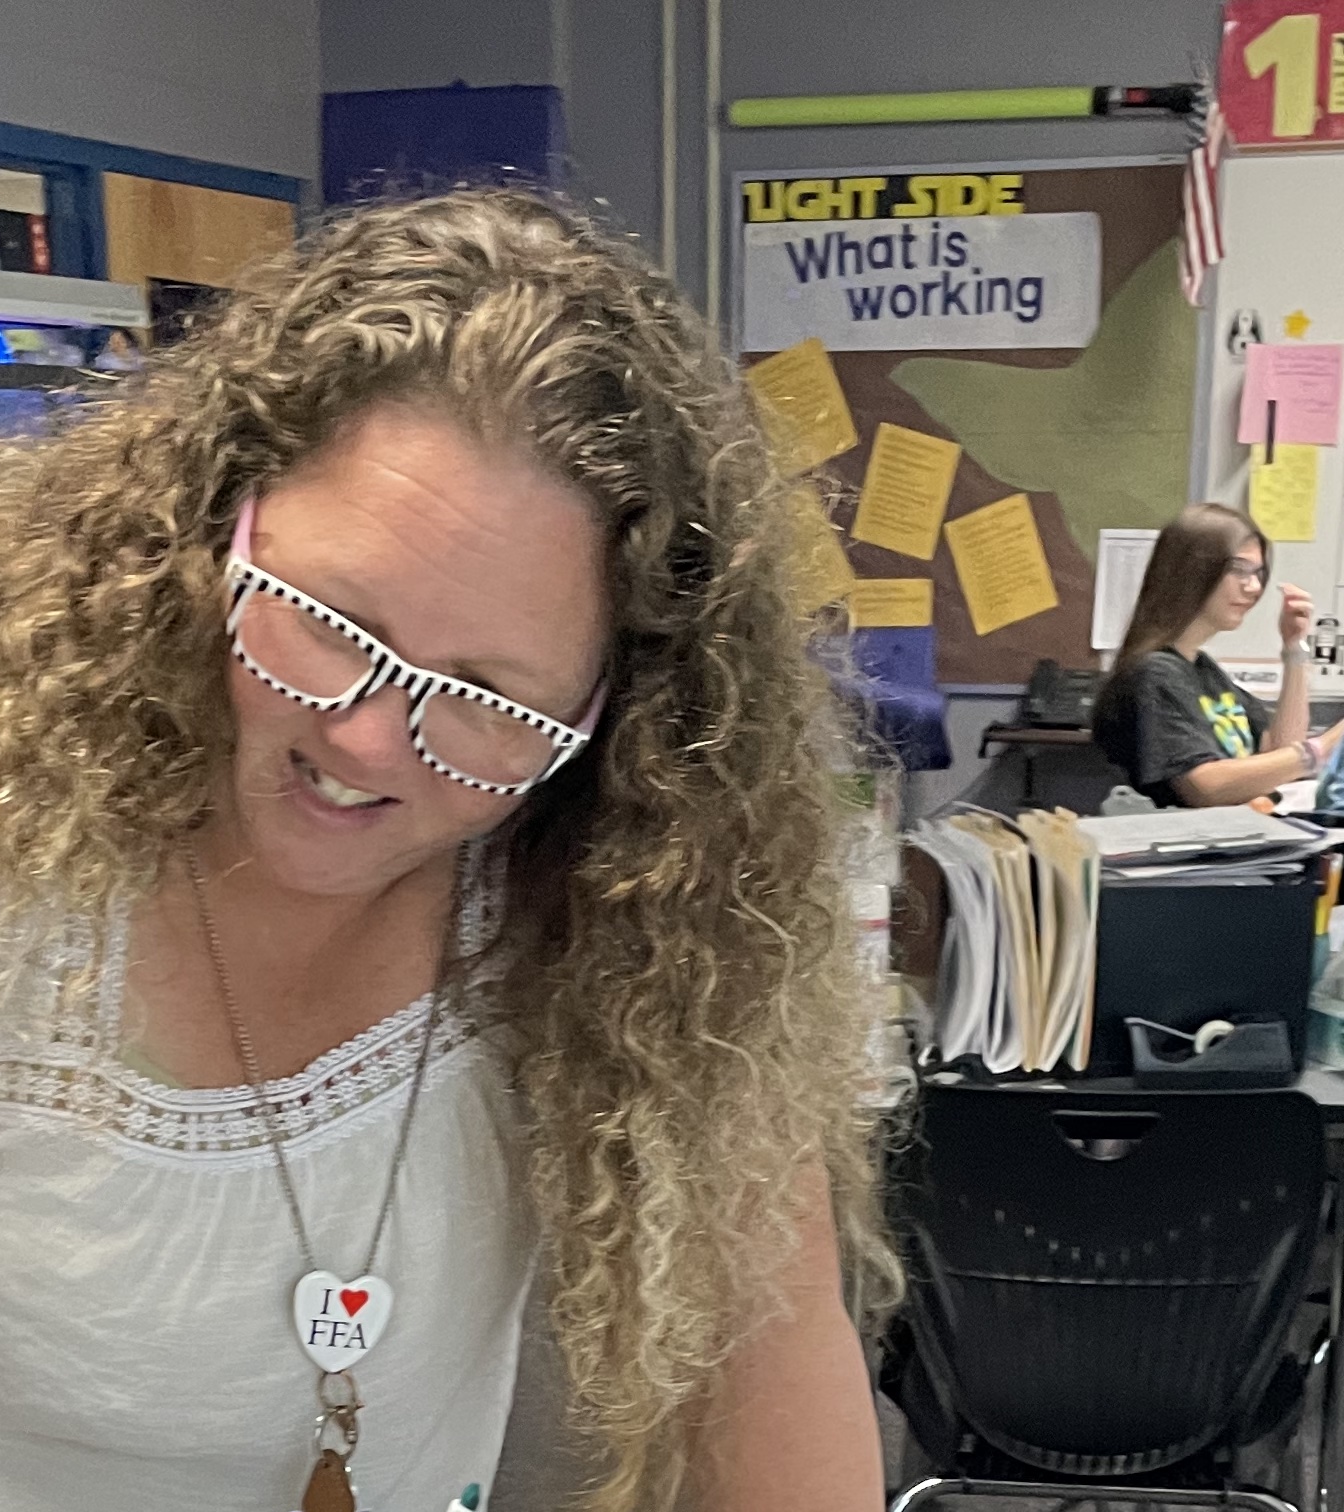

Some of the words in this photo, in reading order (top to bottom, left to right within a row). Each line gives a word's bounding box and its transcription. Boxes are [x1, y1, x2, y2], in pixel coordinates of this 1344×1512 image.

[1244, 14, 1321, 137] 1
[742, 178, 887, 222] LIGHT
[893, 174, 1024, 217] SIDE
[785, 224, 918, 283] What
[930, 221, 969, 267] is
[847, 268, 1045, 323] working
[320, 1288, 336, 1316] I
[307, 1319, 368, 1349] FFA
